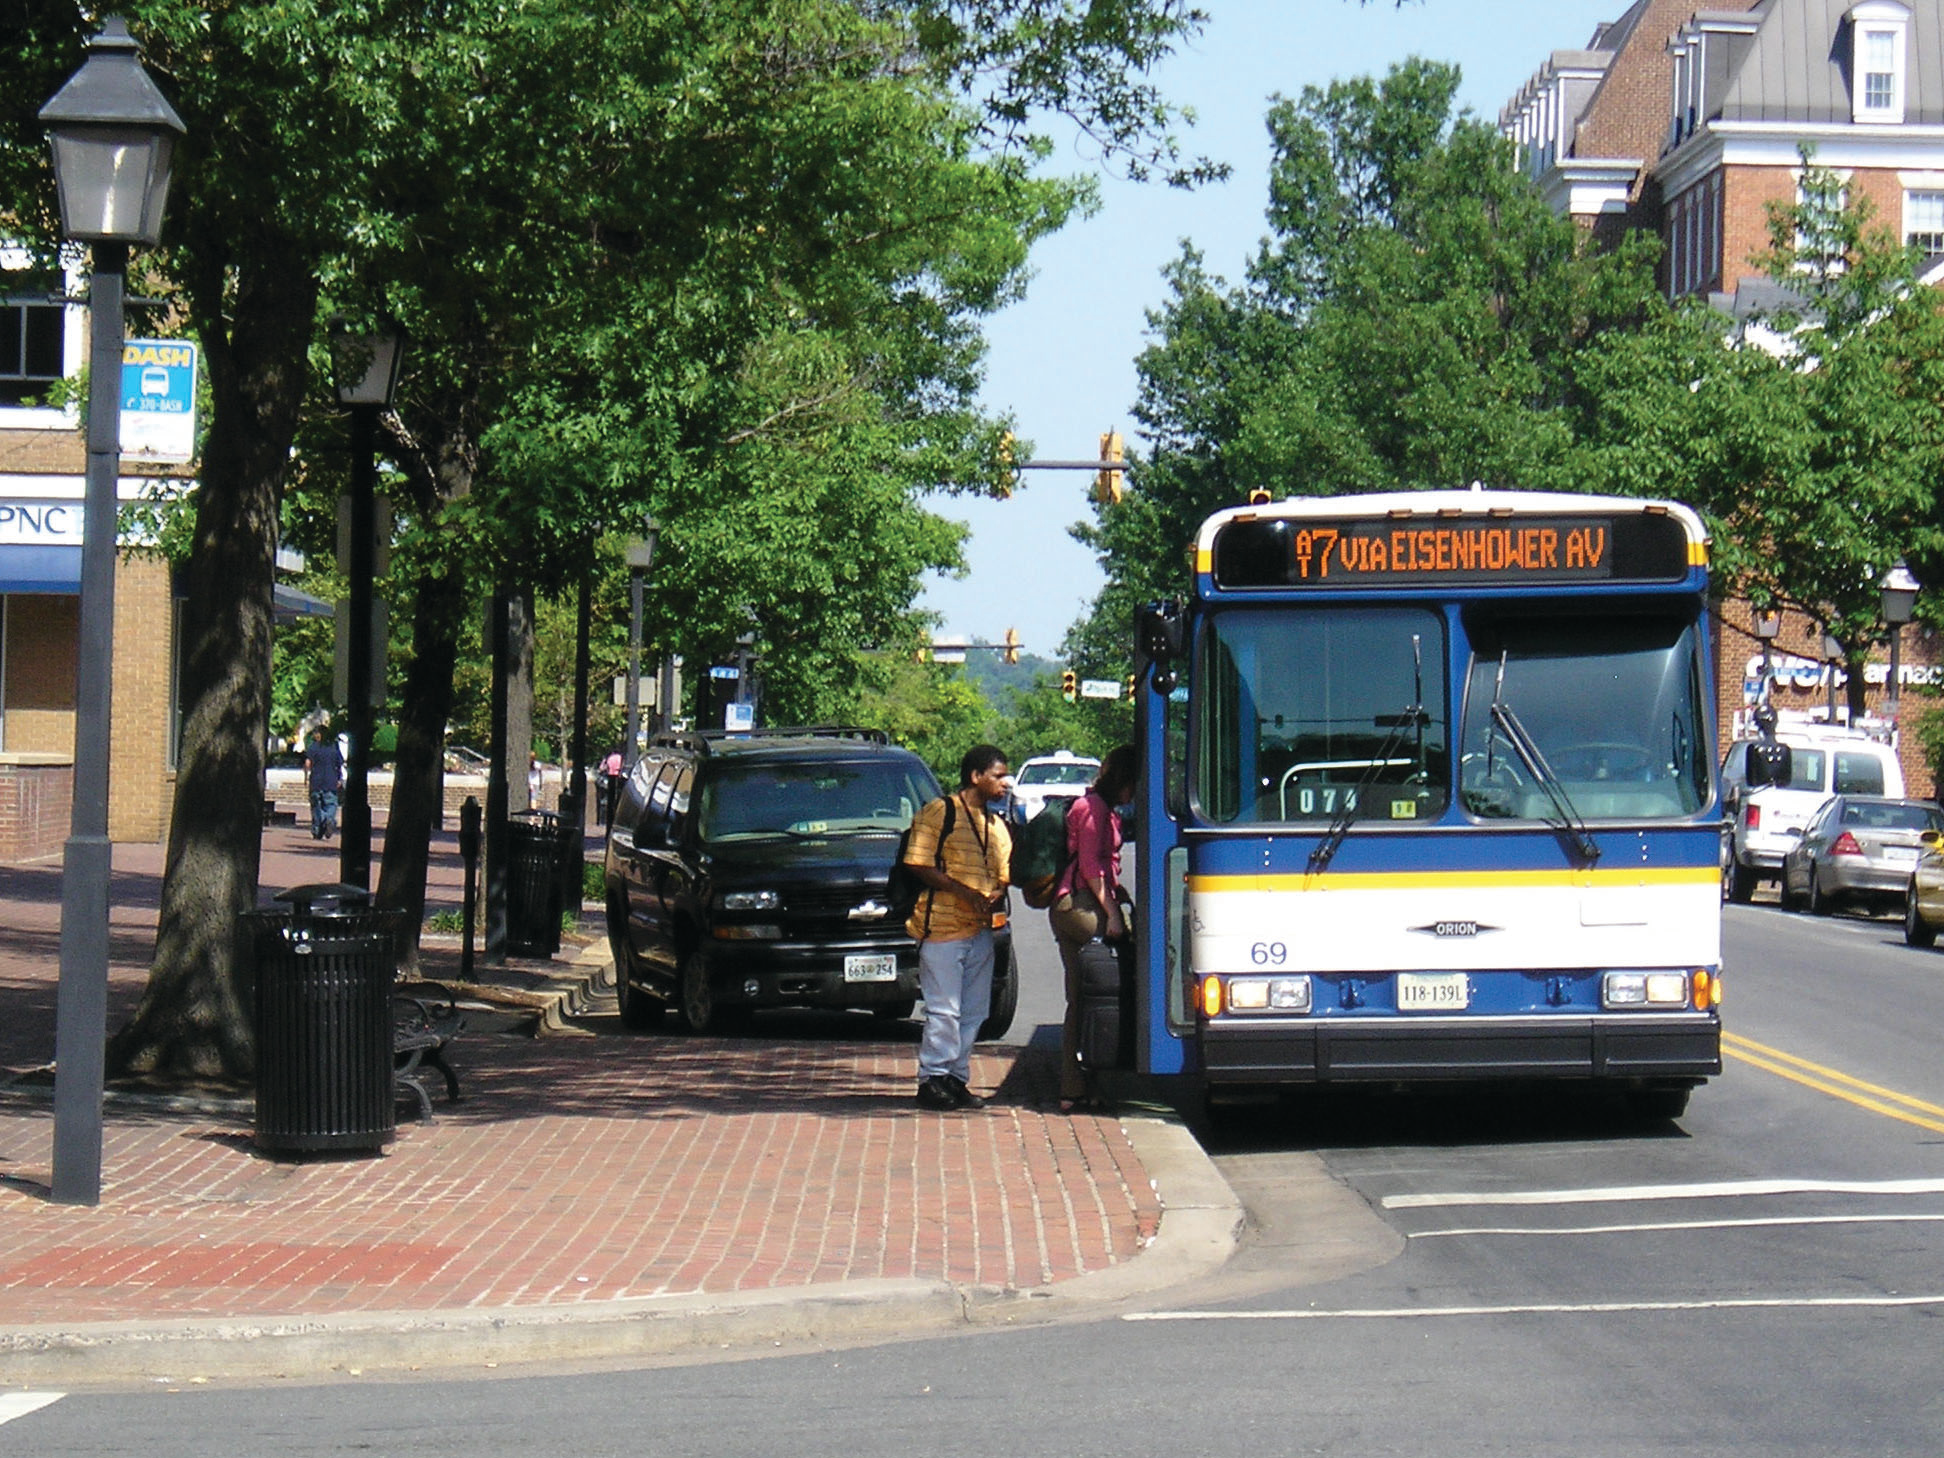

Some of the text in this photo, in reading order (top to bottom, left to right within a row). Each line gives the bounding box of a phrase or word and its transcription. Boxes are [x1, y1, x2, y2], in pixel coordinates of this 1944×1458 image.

[122, 346, 190, 367] DASH
[0, 506, 67, 534] PNC
[1340, 537, 1388, 572] VIA
[1391, 528, 1558, 571] EISENHOWER
[1566, 527, 1604, 569] AV
[1436, 922, 1477, 936] ORION
[1251, 941, 1287, 966] 69
[1404, 985, 1463, 1001] 118-139L
